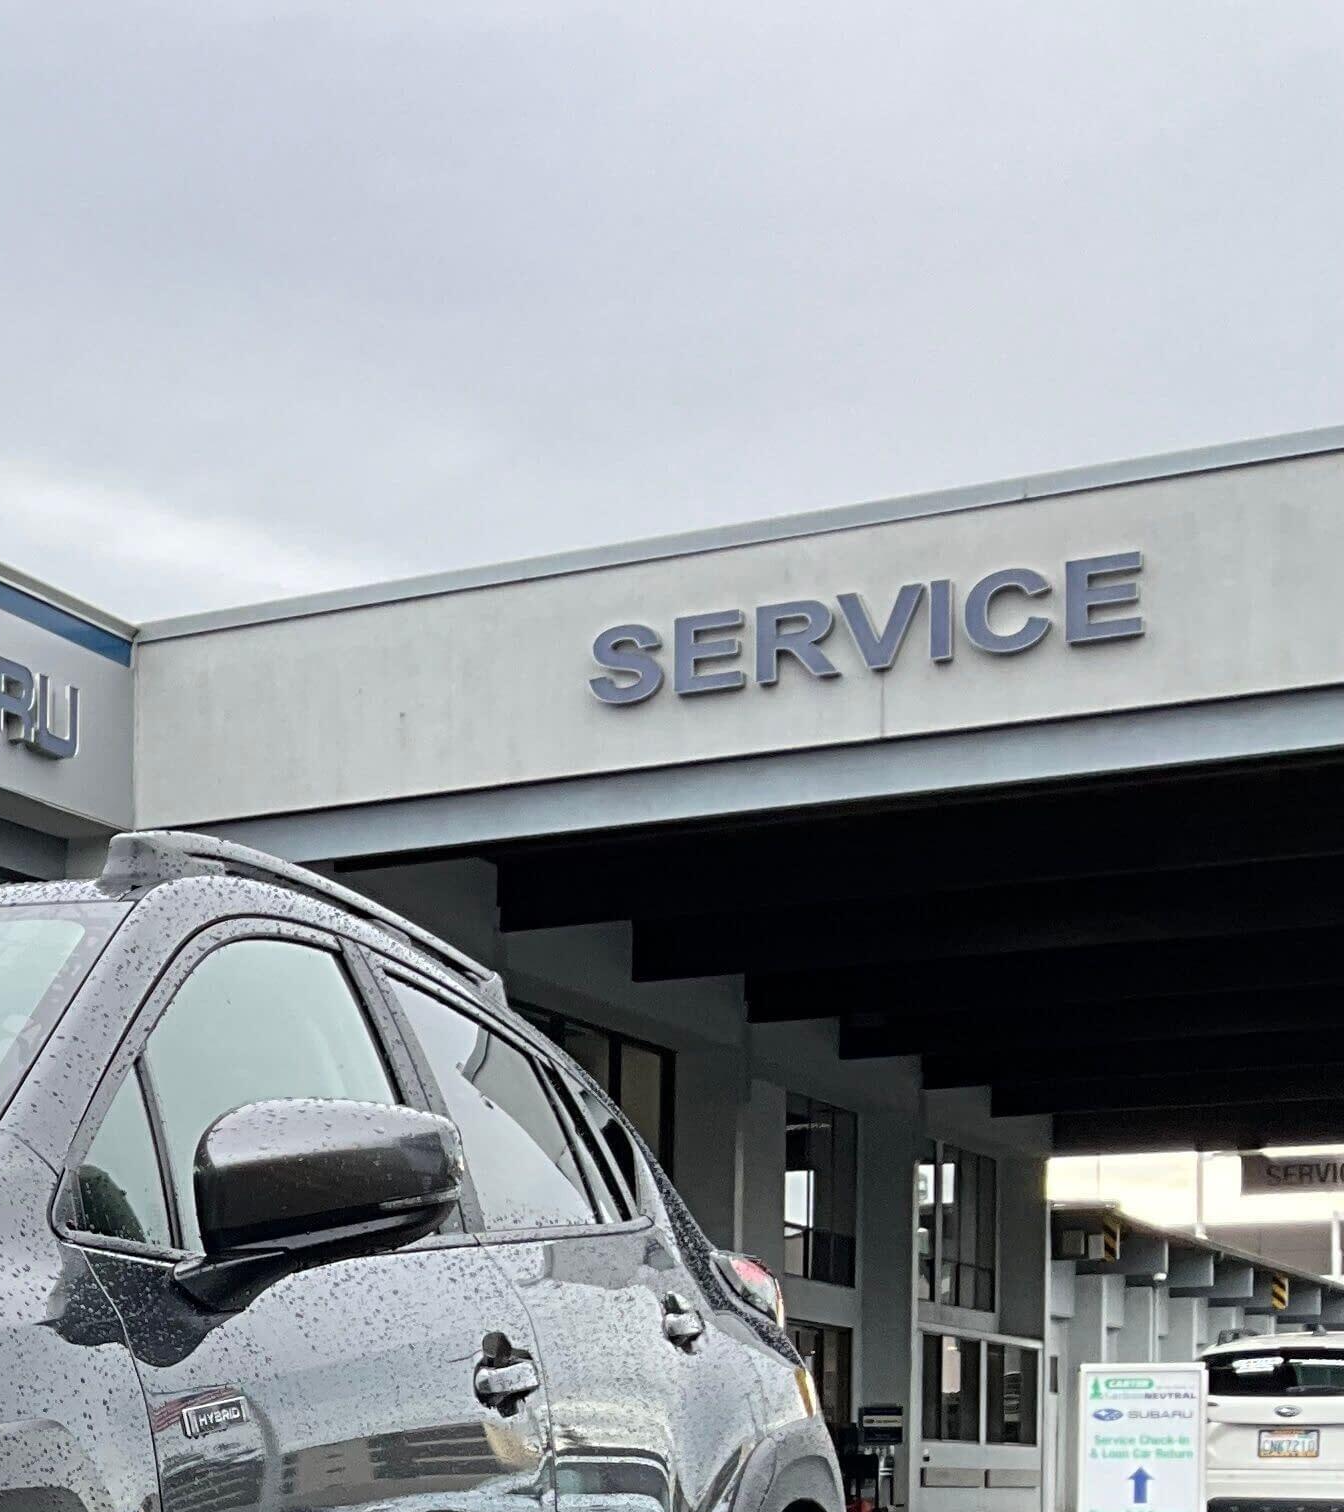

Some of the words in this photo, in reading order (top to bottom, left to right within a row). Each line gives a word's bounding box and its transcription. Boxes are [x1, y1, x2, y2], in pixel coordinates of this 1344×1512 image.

[589, 551, 1145, 706] SERVICE
[198, 1407, 241, 1426] HYBRID
[1128, 1410, 1193, 1419] SUBARU
[1094, 1434, 1135, 1446] Service
